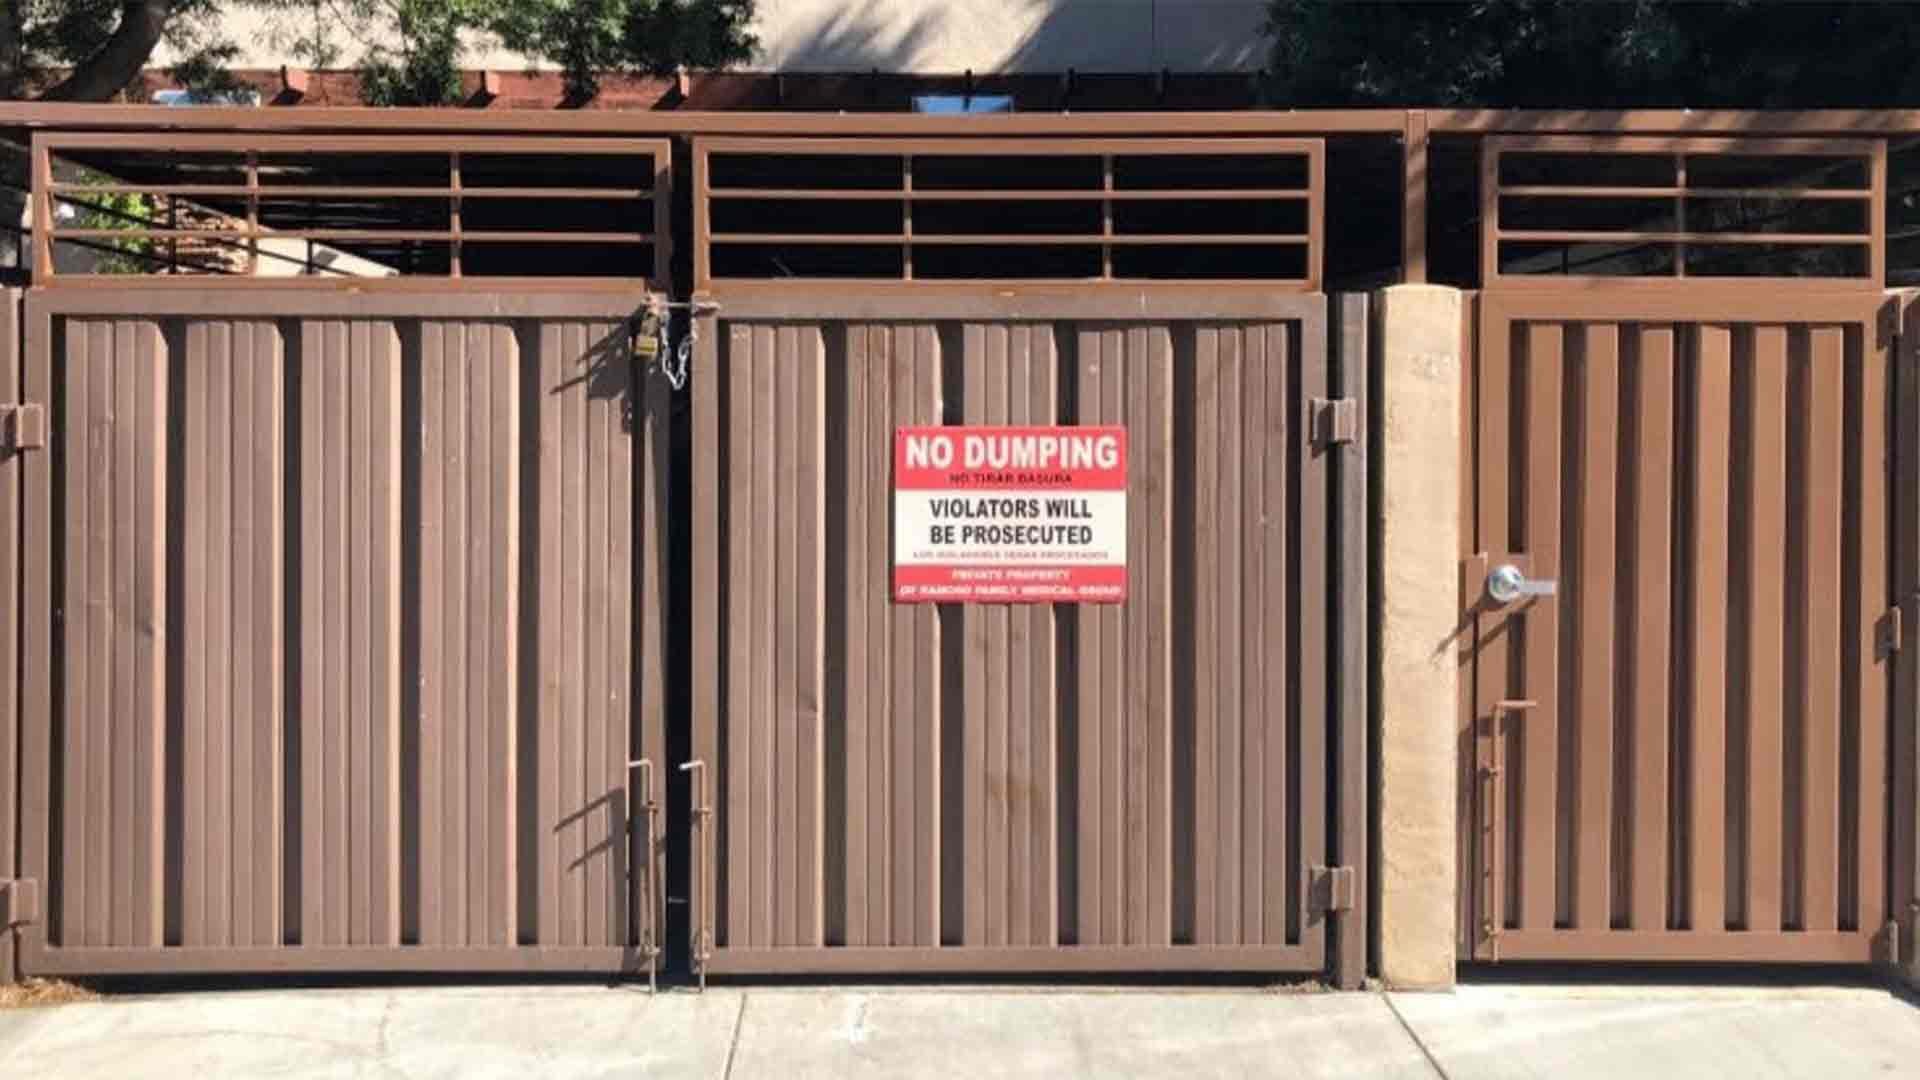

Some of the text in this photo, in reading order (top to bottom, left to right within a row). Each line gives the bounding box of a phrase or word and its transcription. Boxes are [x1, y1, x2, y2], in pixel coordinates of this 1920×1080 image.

[905, 435, 1119, 469] NO DUMPING
[949, 472, 969, 485] NO
[930, 499, 1092, 518] VIOLATORS WILL
[930, 525, 1092, 545] BE PROSECUTED
